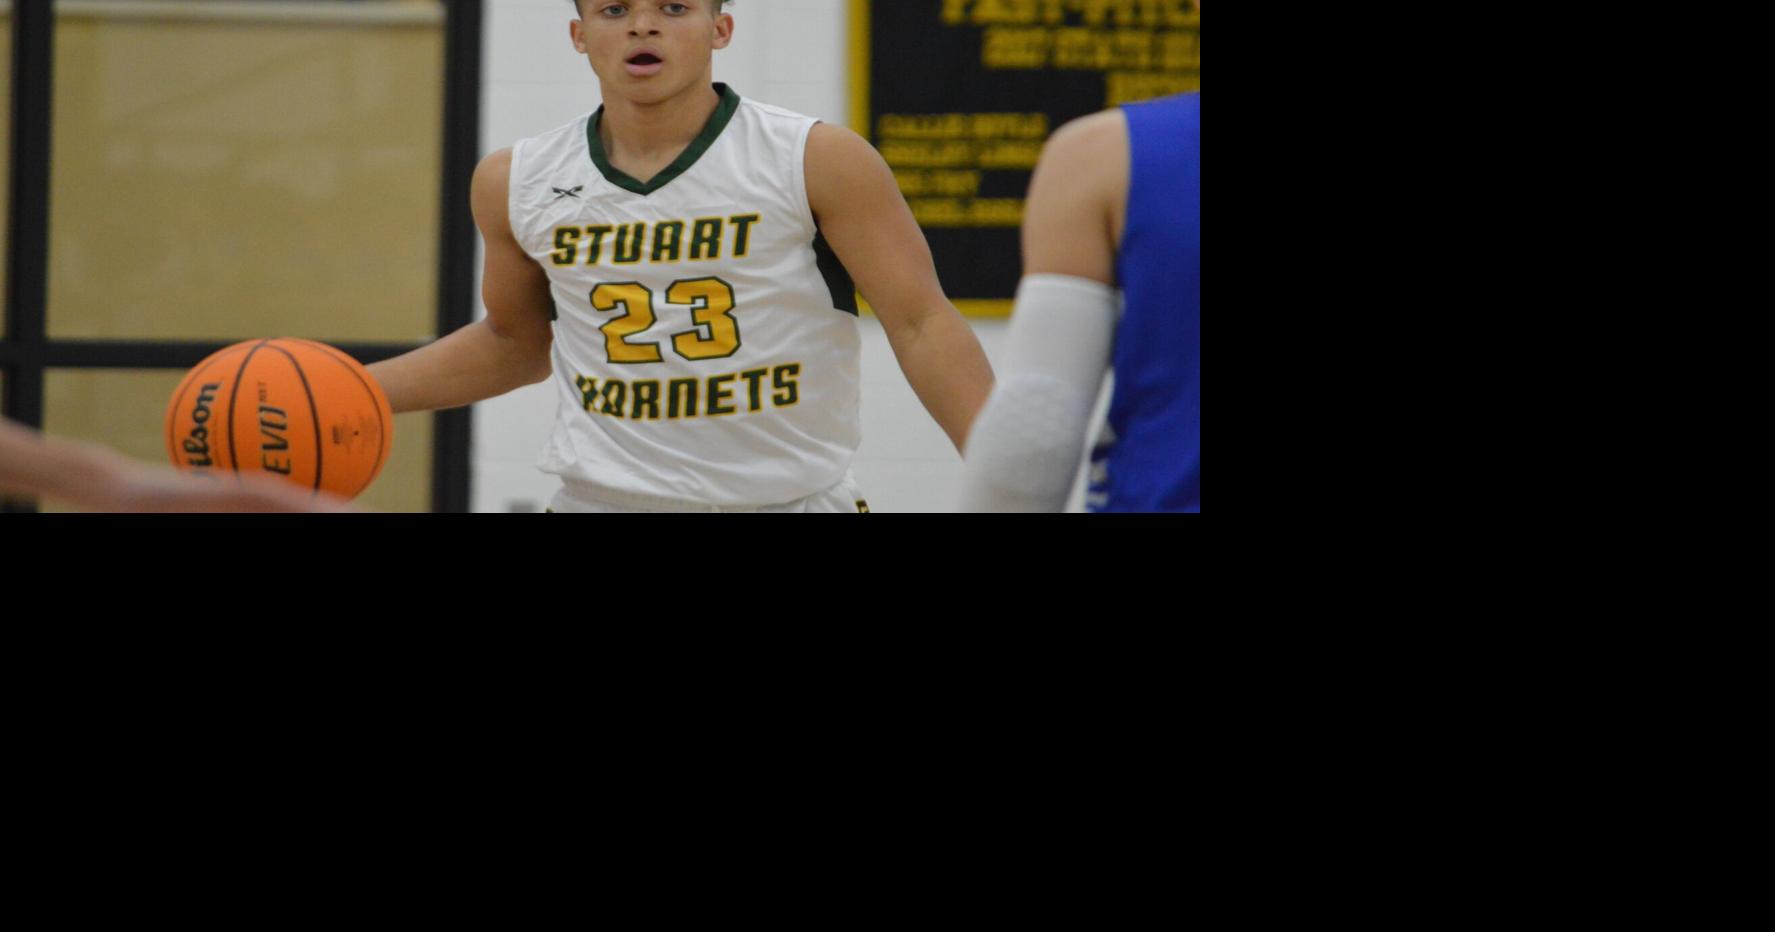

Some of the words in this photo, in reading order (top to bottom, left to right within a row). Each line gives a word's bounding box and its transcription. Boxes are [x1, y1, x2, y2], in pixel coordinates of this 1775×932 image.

[551, 213, 761, 266] STUART
[589, 276, 742, 364] 23
[575, 362, 802, 421] HORNETS
[184, 383, 223, 477] ilson
